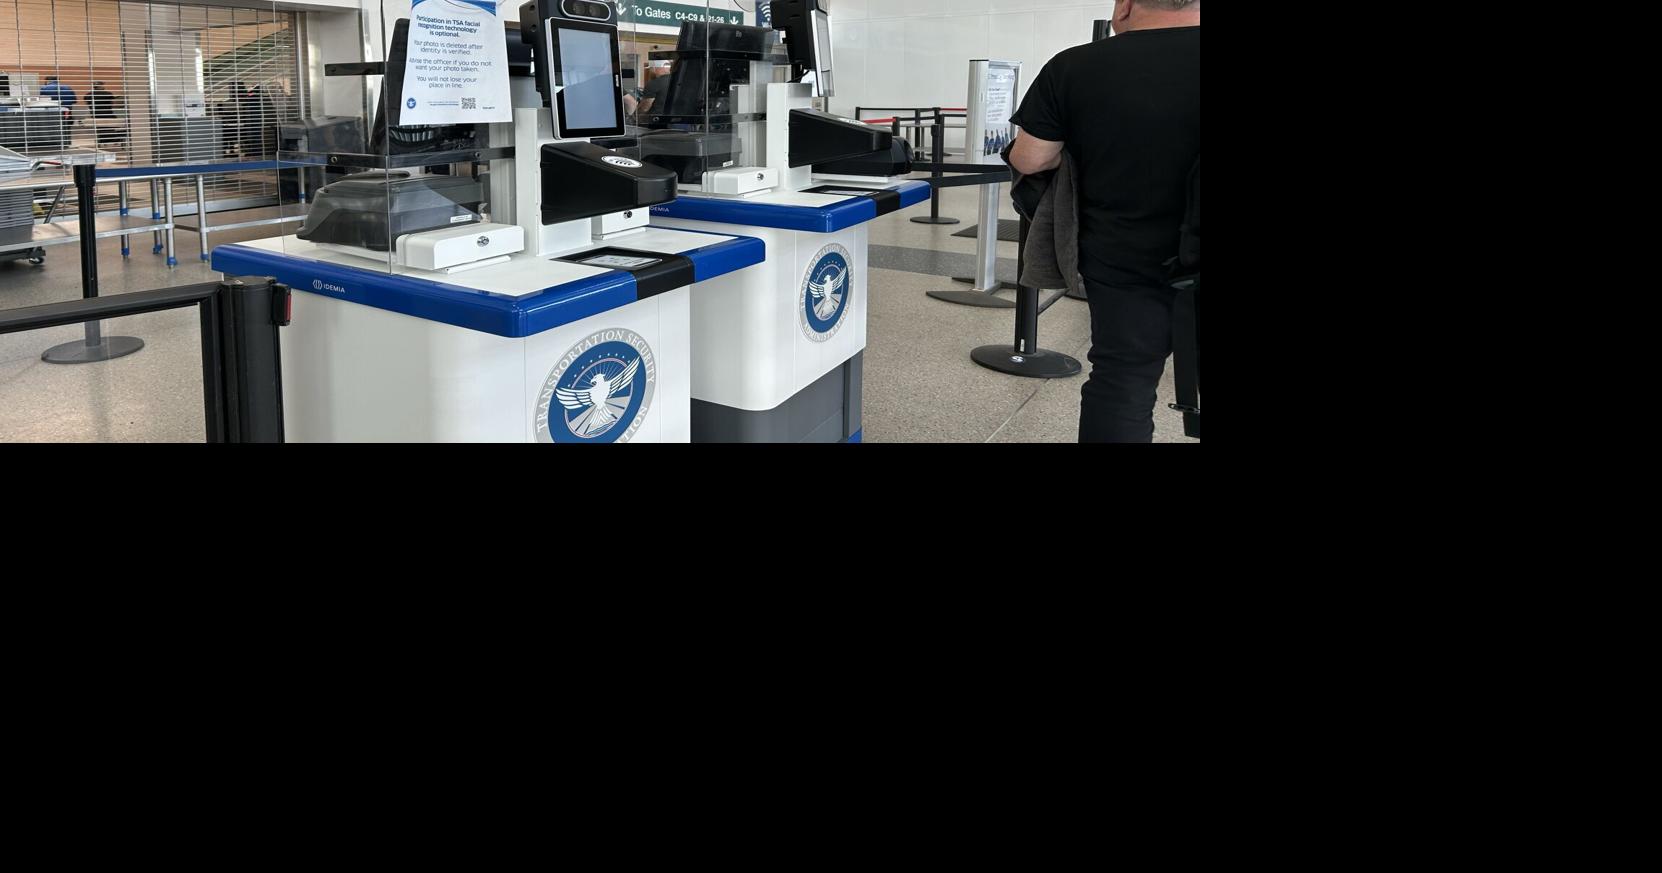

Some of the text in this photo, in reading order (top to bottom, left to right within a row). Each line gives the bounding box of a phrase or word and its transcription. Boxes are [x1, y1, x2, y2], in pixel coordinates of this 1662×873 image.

[645, 6, 671, 19] Gates
[675, 12, 698, 22] C4-C9
[445, 24, 477, 33] technology
[323, 283, 346, 293] IDEMIA
[536, 330, 624, 432] TRANSPORTATION
[626, 333, 655, 383] SECURITY
